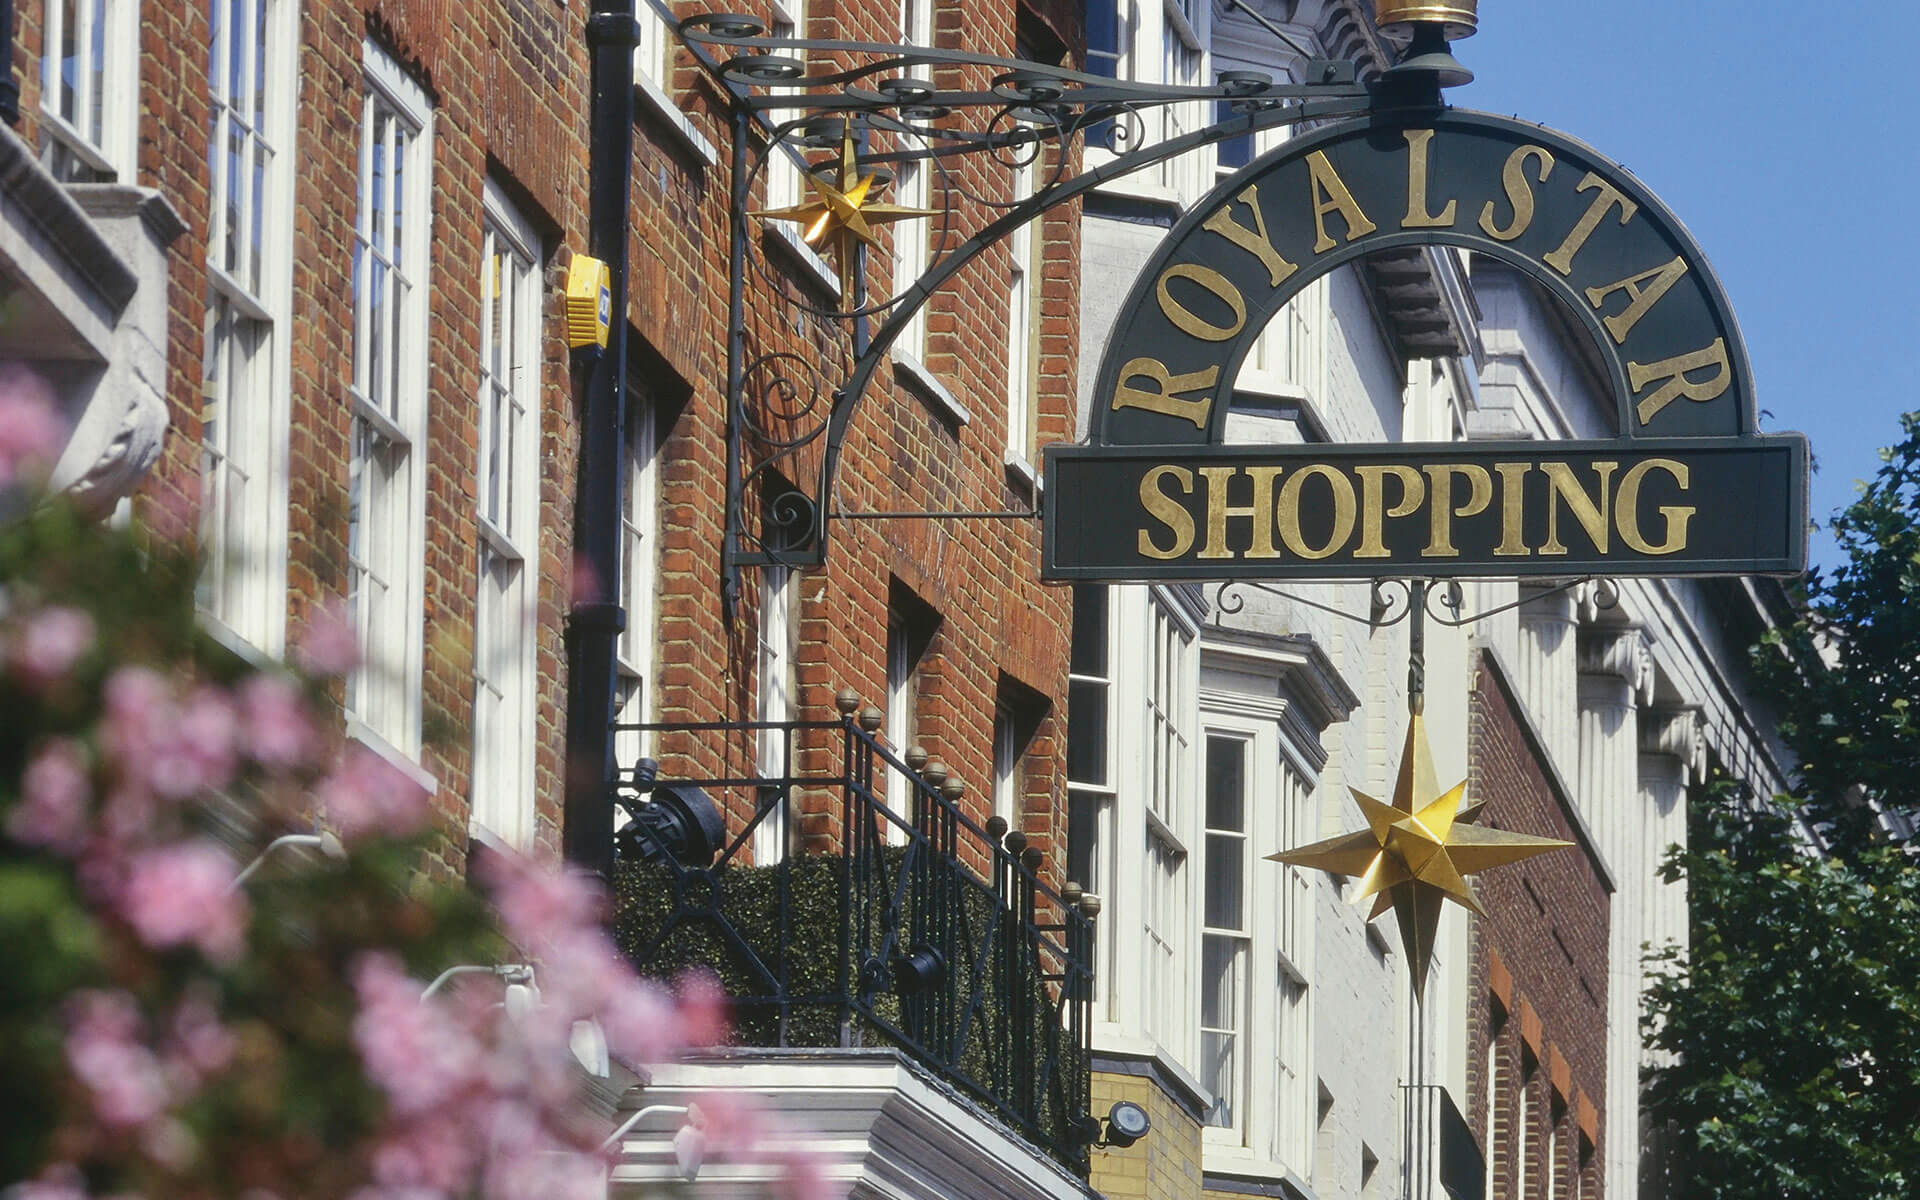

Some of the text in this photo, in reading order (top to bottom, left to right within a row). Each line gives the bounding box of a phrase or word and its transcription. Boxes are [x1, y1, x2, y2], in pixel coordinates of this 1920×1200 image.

[1112, 128, 1733, 429] ROYAL STAR
[1137, 458, 1697, 559] SHOPPING
